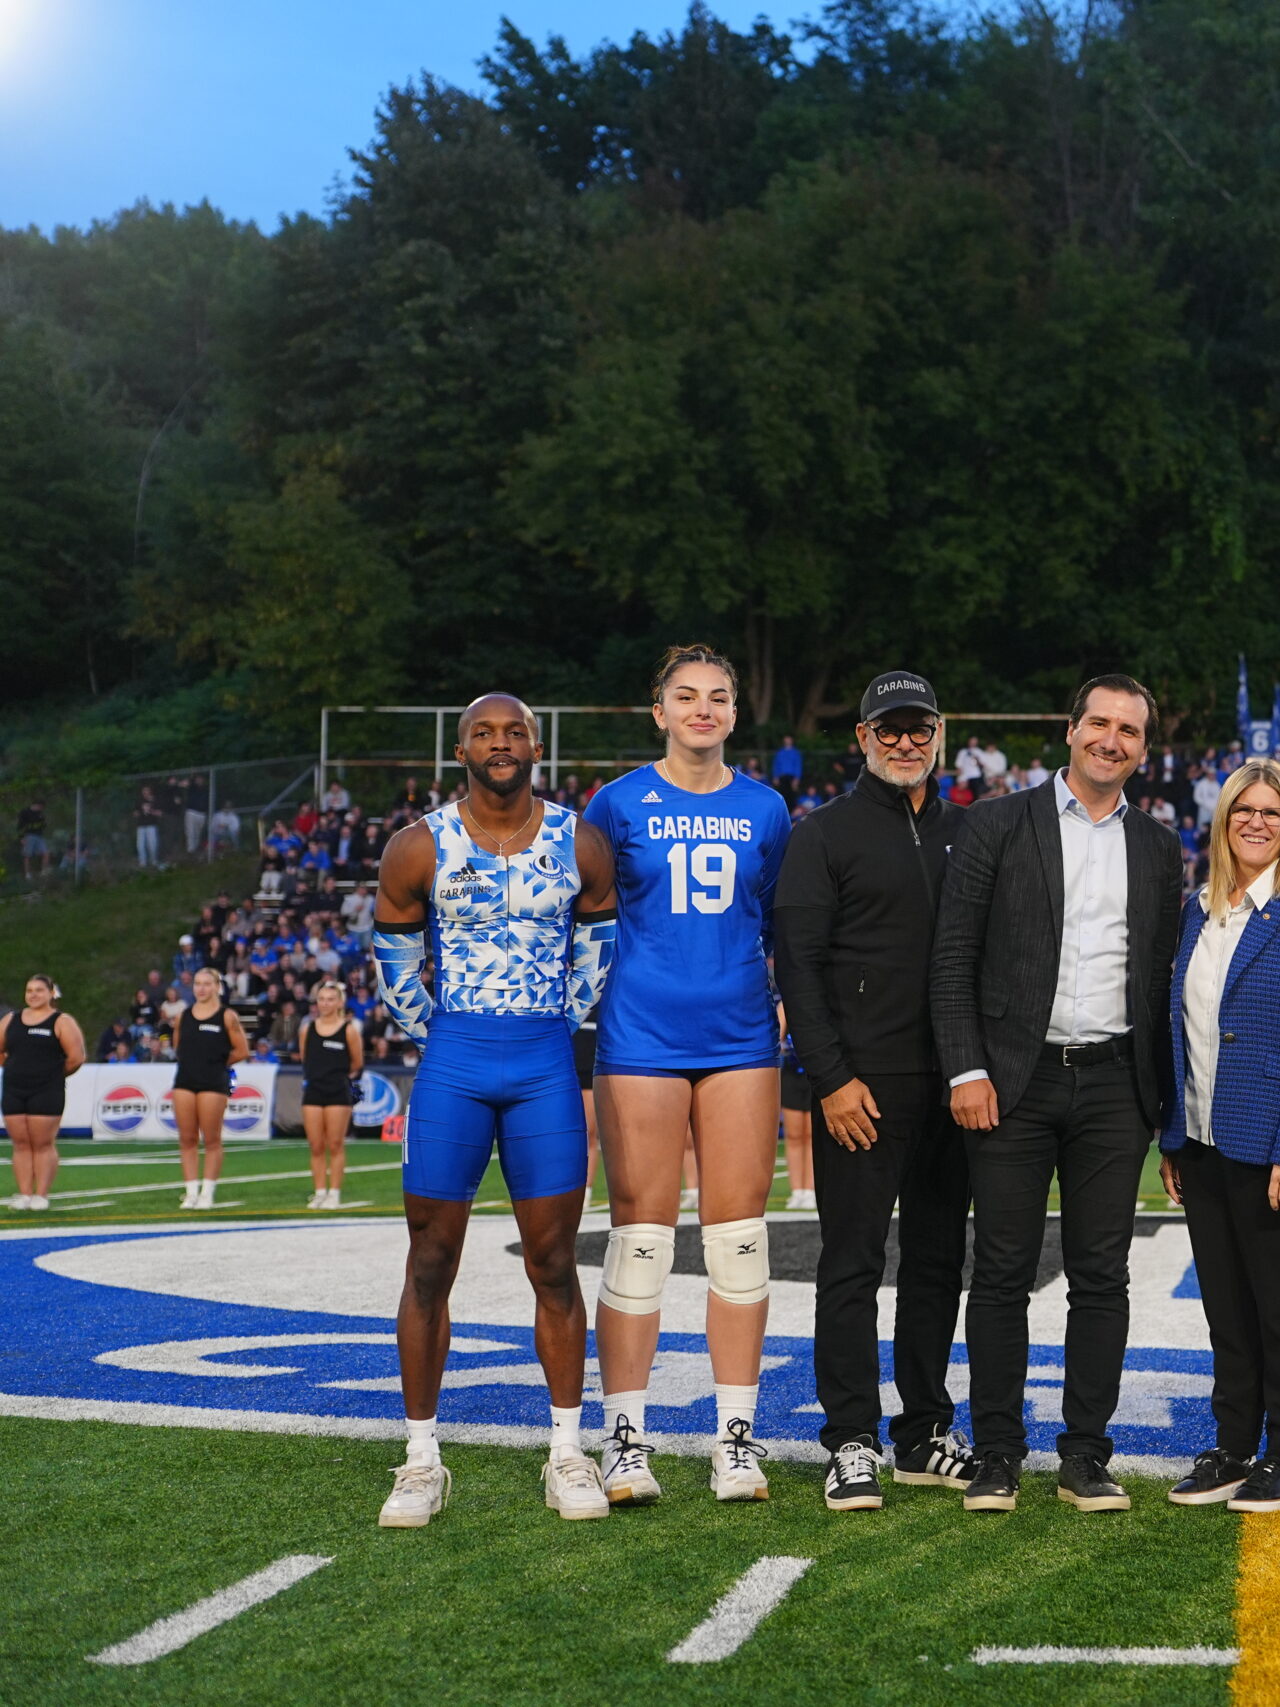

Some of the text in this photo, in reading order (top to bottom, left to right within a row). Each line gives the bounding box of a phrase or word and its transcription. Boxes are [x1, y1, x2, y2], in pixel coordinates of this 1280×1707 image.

[877, 680, 926, 696] CARABINS
[1252, 730, 1269, 752] 6
[647, 816, 752, 842] CARABINS
[450, 874, 482, 883] adidas
[667, 843, 737, 914] 19
[439, 885, 492, 899] CARABINS
[102, 1103, 147, 1114] PEPSI
[228, 1104, 263, 1113] EPSI
